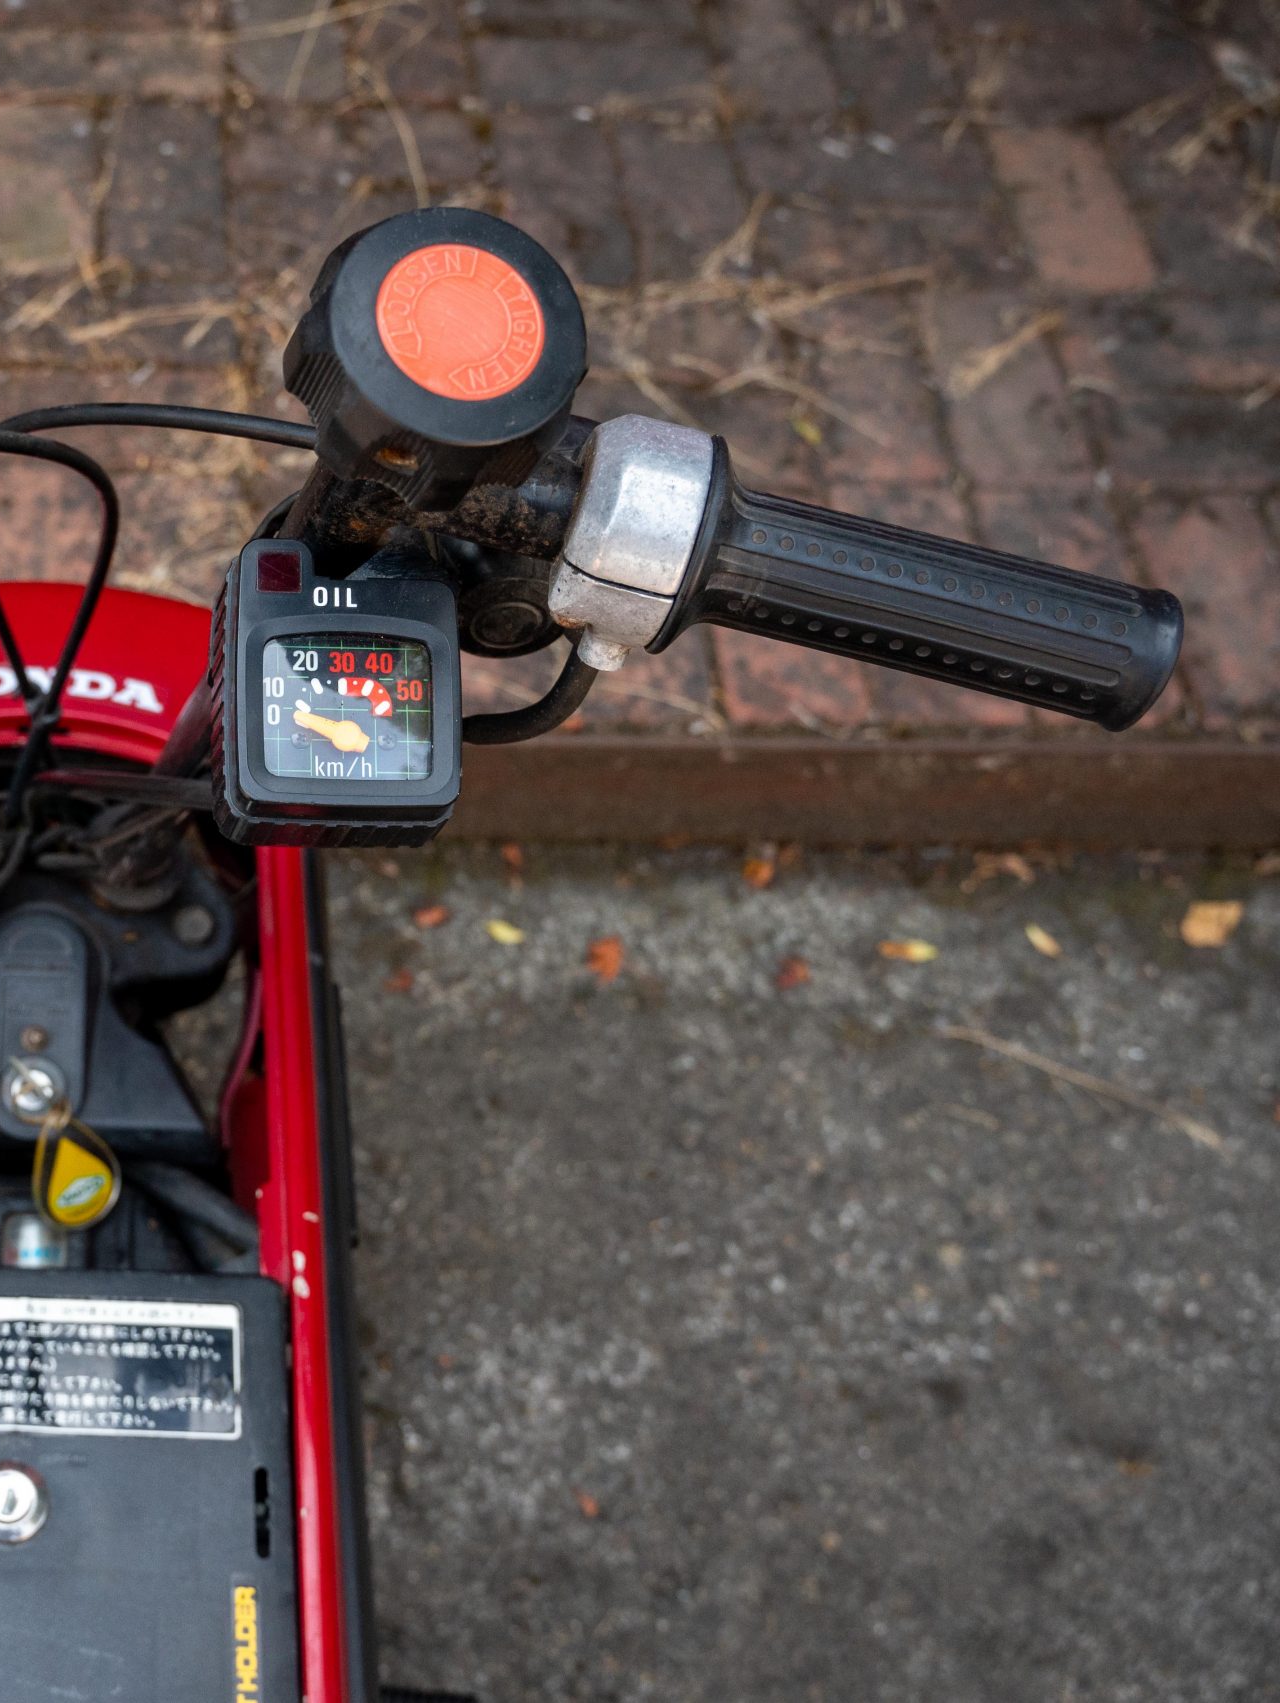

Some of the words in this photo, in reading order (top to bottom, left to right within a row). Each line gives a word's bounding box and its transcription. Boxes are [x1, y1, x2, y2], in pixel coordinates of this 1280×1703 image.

[387, 250, 463, 337] LOOSEN
[468, 289, 537, 389] TIGHTEN
[313, 587, 358, 608] OIL
[292, 650, 319, 672] 20
[329, 652, 355, 674] 30
[365, 652, 393, 674] 40
[263, 677, 285, 698] 10
[397, 680, 423, 701] 50
[267, 704, 280, 725] 0
[315, 756, 373, 778] km/h
[234, 1586, 258, 1691] HOLDER
